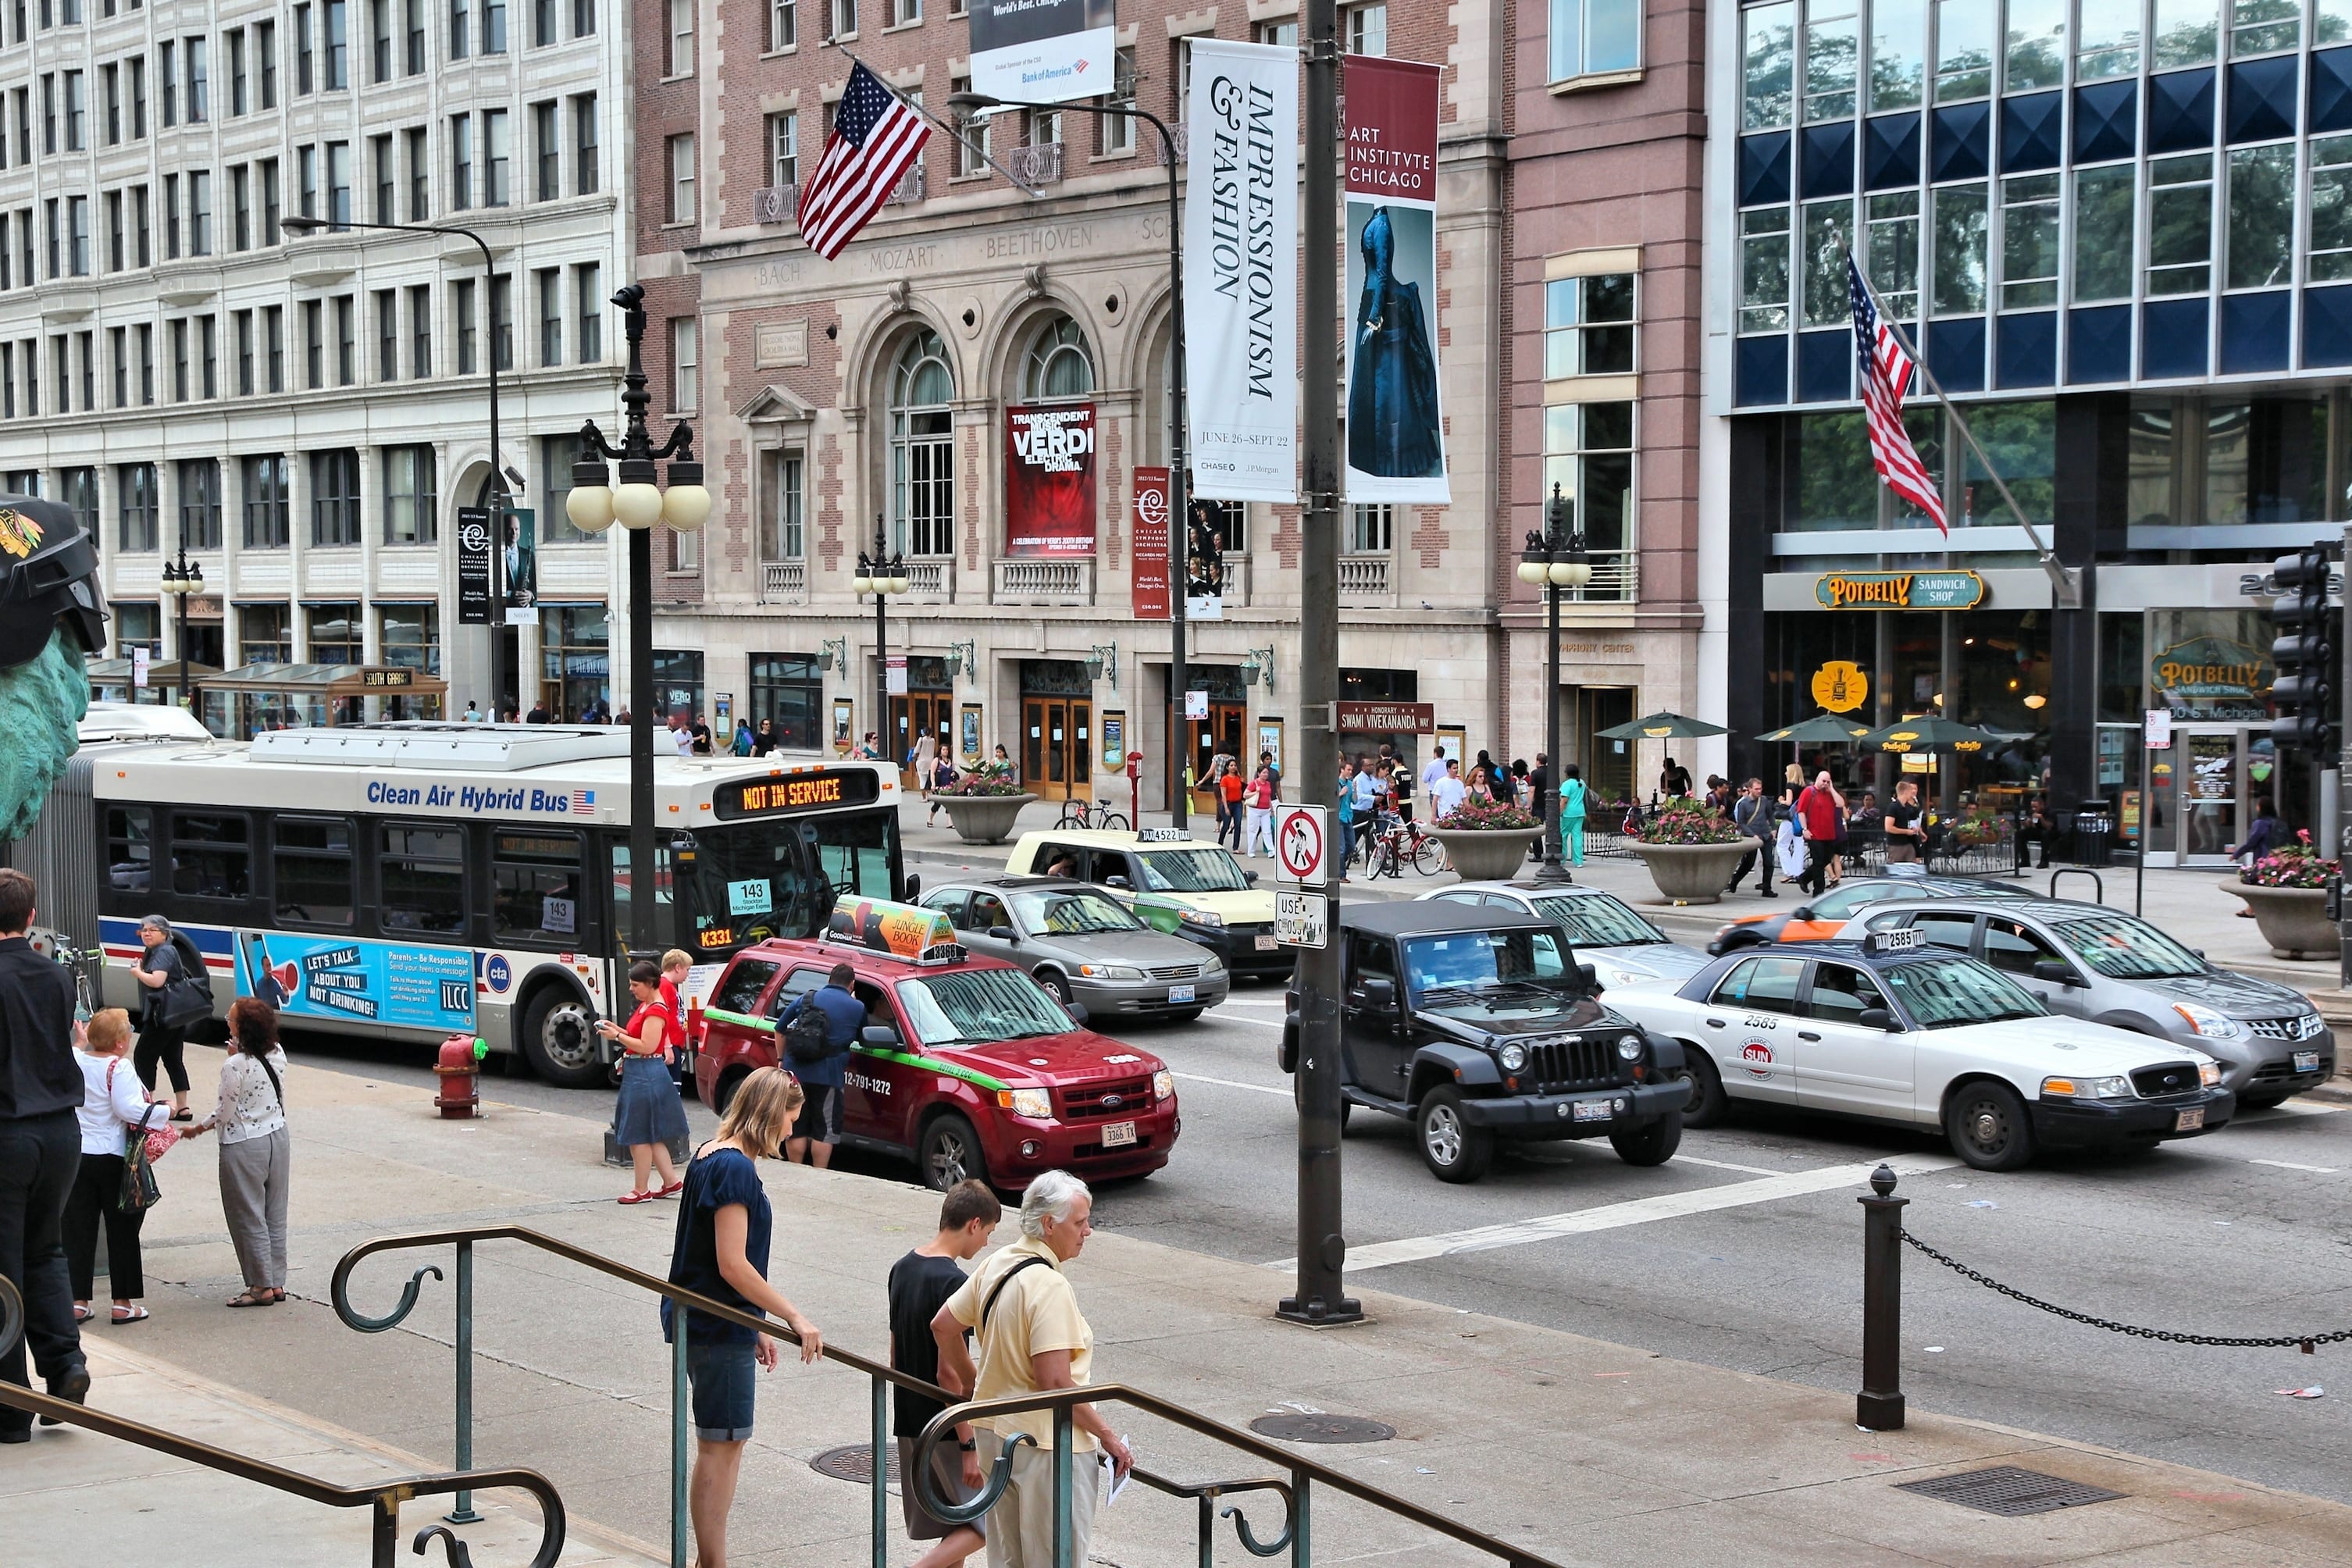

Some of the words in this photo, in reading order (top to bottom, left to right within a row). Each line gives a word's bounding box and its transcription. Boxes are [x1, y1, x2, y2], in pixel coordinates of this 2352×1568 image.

[993, 1, 1017, 16] World's
[1022, 69, 1038, 84] Bank
[1038, 69, 1046, 81] of
[1045, 66, 1071, 80] America
[1210, 75, 1243, 131] &
[1349, 126, 1381, 143] ART
[1350, 146, 1431, 170] INSTITVTE
[1349, 166, 1421, 188] CHICAGO
[1211, 131, 1240, 305] FASHION
[986, 225, 1092, 259] BEETHOVEN
[1247, 80, 1274, 401] IMPRESSIONISM
[869, 244, 936, 273] MOZART
[760, 262, 800, 286] BACH
[1011, 411, 1090, 425] TRANSCENDENT
[1030, 422, 1064, 432] MUSIC.
[1012, 427, 1094, 457] VERDI
[1200, 431, 1229, 444] JUNE
[1277, 437, 1288, 447] 22
[1025, 453, 1072, 465] ELECTRIC
[1045, 461, 1083, 472] DRAMA.
[1201, 462, 1228, 471] CHASE
[1919, 579, 1966, 590] SANDWICH
[1930, 591, 1954, 601] SHOP
[1559, 643, 1598, 653] YMPHONY
[1602, 643, 1634, 654] CENTER
[365, 672, 385, 686] SOUTH
[1342, 714, 1363, 728] SWAMI
[1367, 715, 1417, 729] VIVEKANANDA
[1420, 718, 1430, 728] WAY
[2209, 707, 2267, 721] Michigan
[1882, 741, 1912, 752] Potbelly
[367, 782, 420, 804] Clean
[426, 785, 455, 807] Air
[460, 786, 525, 813] Hybrid
[530, 789, 568, 812] Bus
[743, 786, 767, 810] NOT
[771, 784, 786, 807] IN
[789, 779, 841, 805] SERVICE
[1142, 830, 1155, 841] TAXI
[1156, 830, 1177, 840] 4522
[1178, 830, 1190, 841] TAXI
[502, 837, 521, 851] NOT
[741, 883, 764, 899] 143
[550, 901, 567, 917] 143
[1281, 899, 1300, 914] USE
[892, 919, 926, 935] JUNGLE
[701, 928, 732, 947] K331
[829, 930, 853, 942] GOODMAN
[893, 932, 920, 946] BOOK
[1890, 932, 1912, 947] 2585
[389, 951, 412, 961] Parents
[419, 953, 427, 963] Be
[429, 954, 469, 966] Responsible
[935, 944, 956, 959] 3366
[307, 954, 330, 971] LET'S
[332, 949, 354, 966] TALK
[390, 961, 404, 971] Send
[404, 964, 418, 973] your
[441, 967, 469, 978] message!
[490, 968, 508, 979] cta
[314, 972, 340, 987] ABOUT
[344, 975, 360, 989] YOU
[310, 985, 327, 1002] NOT
[330, 991, 375, 1016] DRINKING!
[442, 985, 469, 1010] ILCC
[1744, 1014, 1779, 1030] 2585
[1745, 1049, 1769, 1063] SUN
[960, 1070, 974, 1079] CCC
[1107, 1128, 1124, 1141] 3366
[1127, 1127, 1135, 1138] TX
